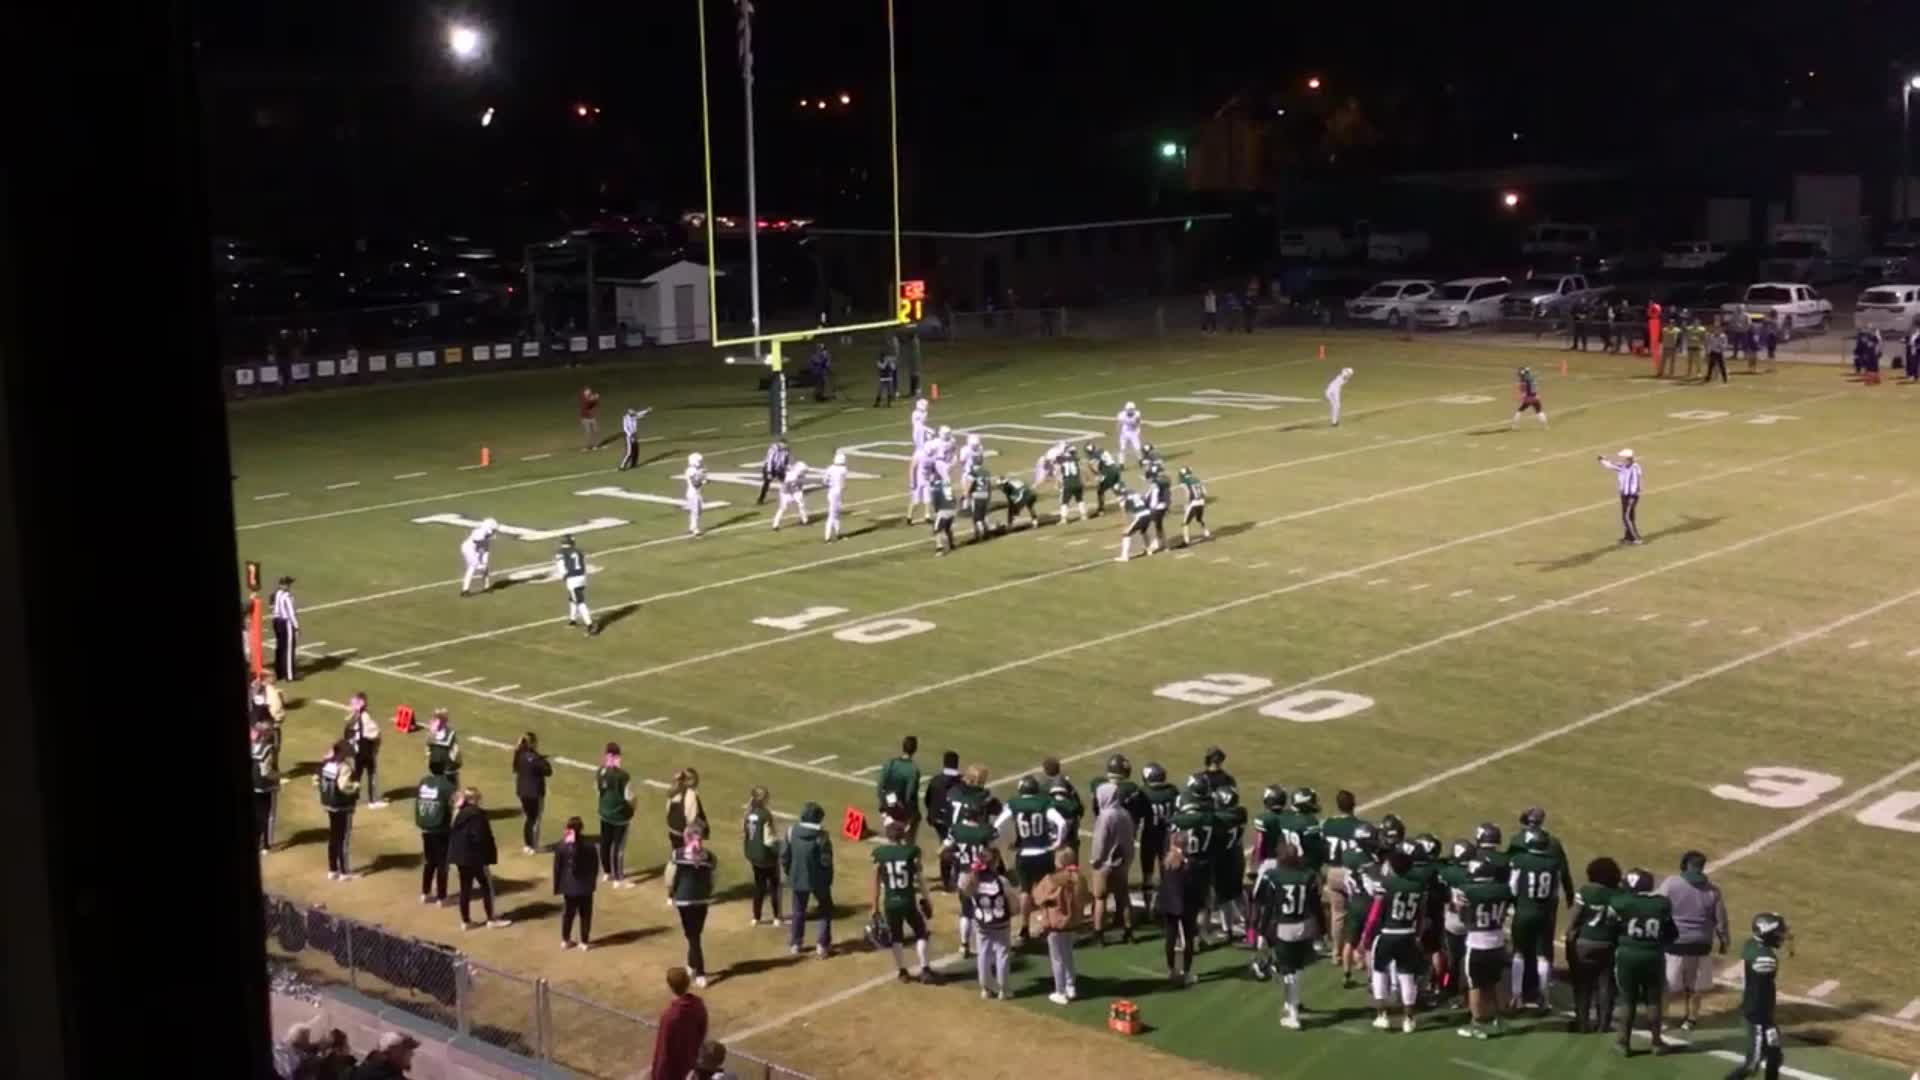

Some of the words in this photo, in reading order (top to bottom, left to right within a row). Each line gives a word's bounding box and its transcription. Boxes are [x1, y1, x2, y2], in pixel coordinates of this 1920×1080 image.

[899, 299, 922, 323] 21
[752, 606, 936, 643] 10
[1152, 672, 1375, 722] 20
[845, 810, 861, 837] 20
[1016, 811, 1044, 839] 60
[1187, 825, 1213, 854] 67
[885, 861, 910, 889] 15
[1527, 871, 1552, 899] 18
[1281, 884, 1307, 915] 31
[1391, 891, 1421, 920] 65
[1475, 902, 1506, 928] 64
